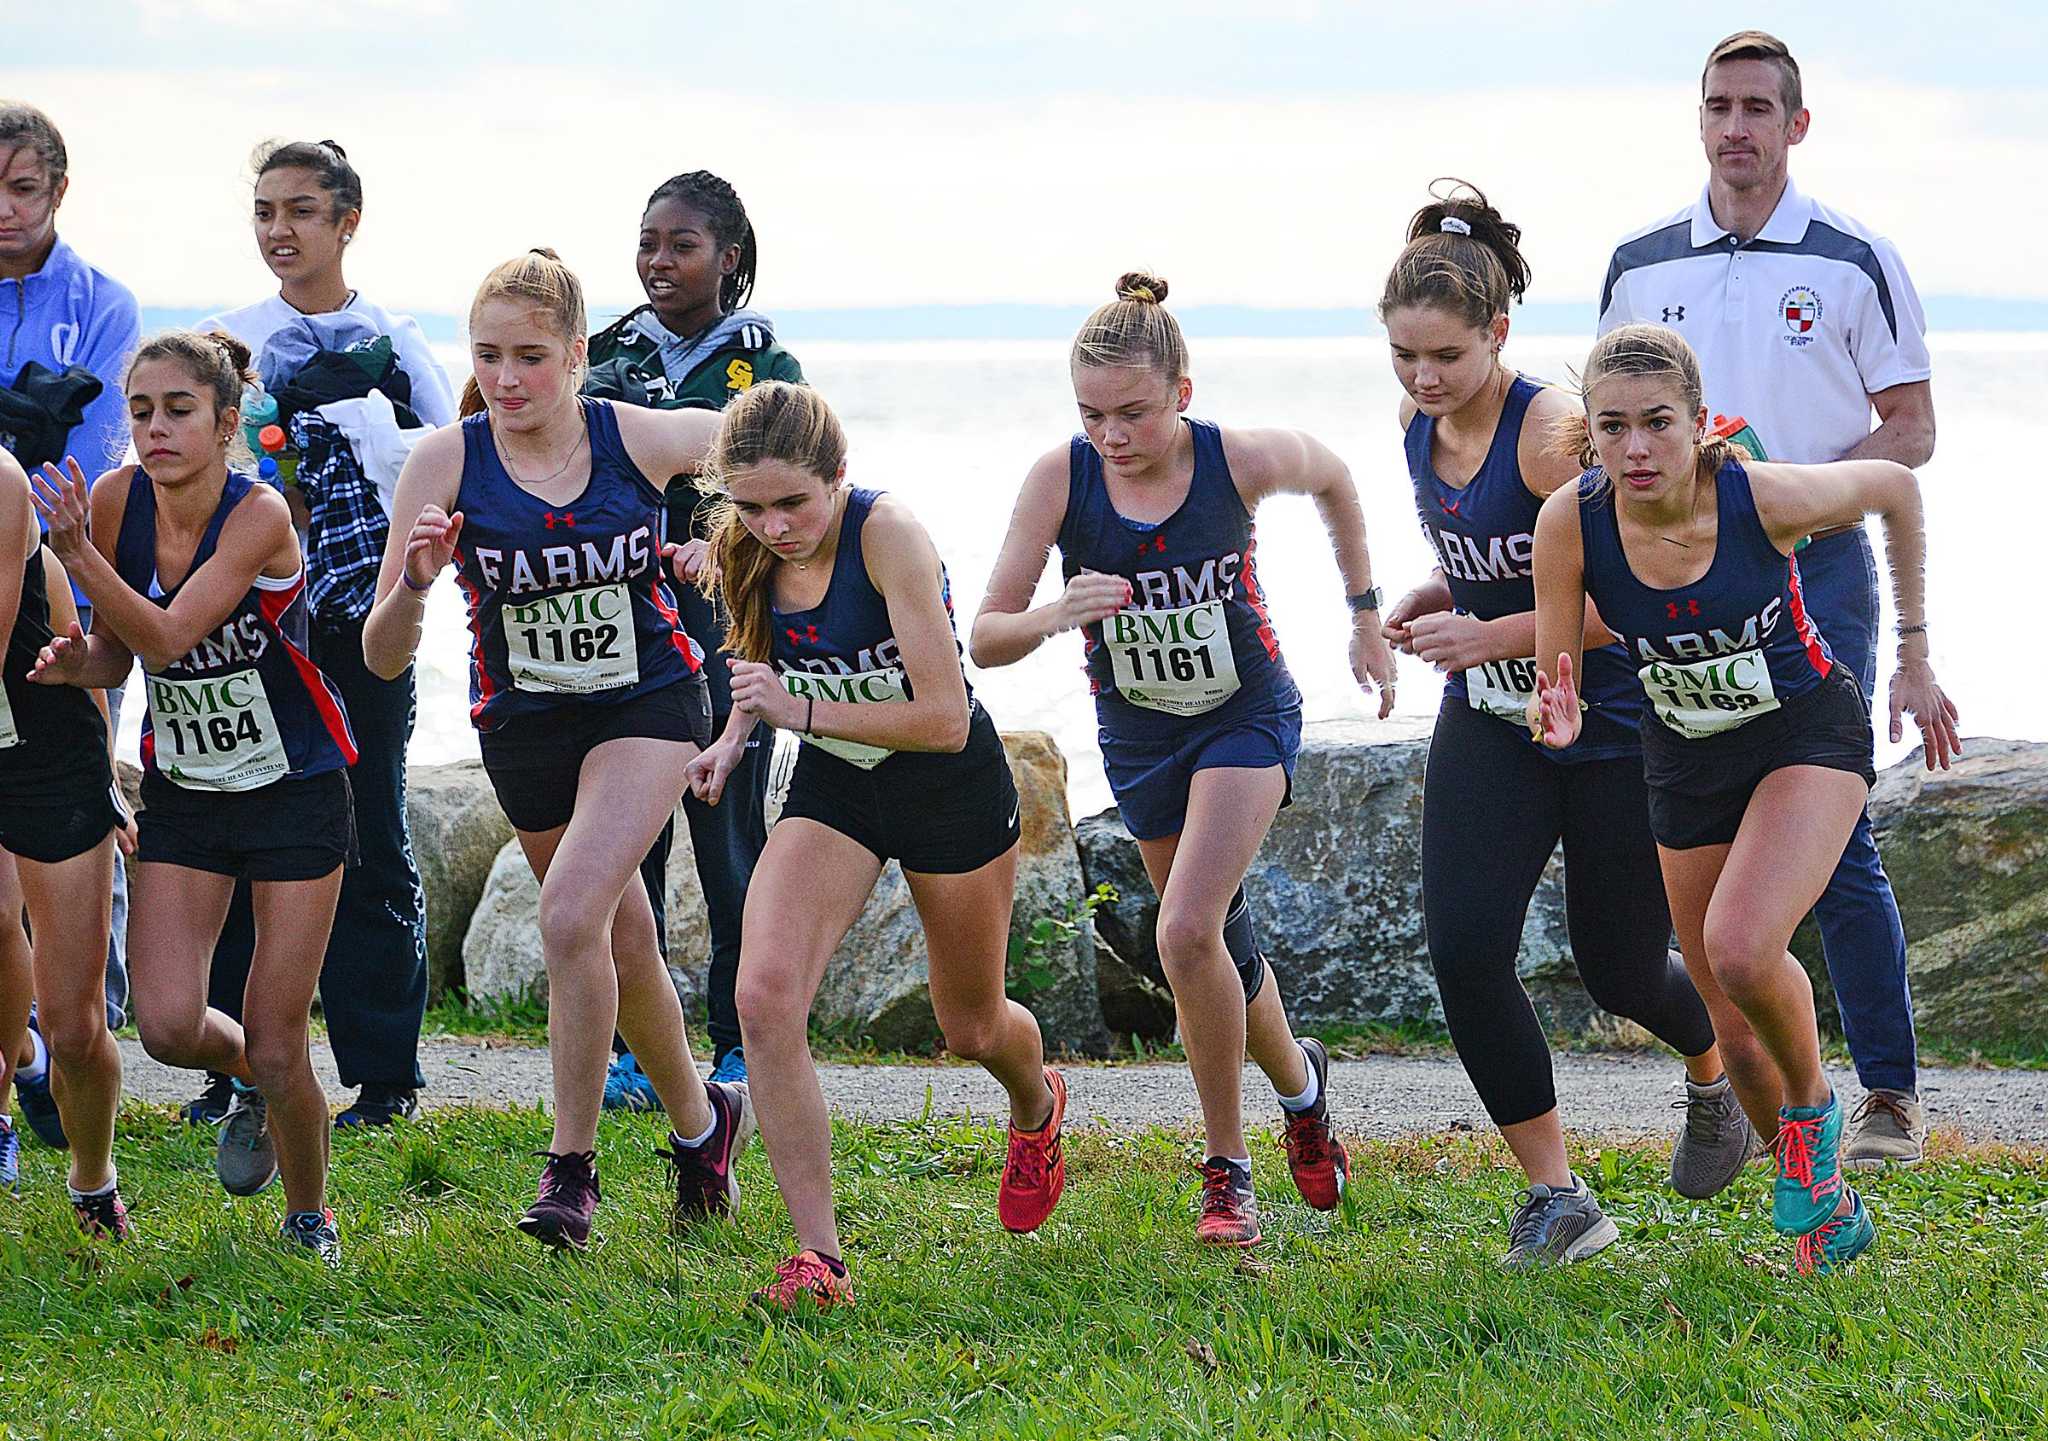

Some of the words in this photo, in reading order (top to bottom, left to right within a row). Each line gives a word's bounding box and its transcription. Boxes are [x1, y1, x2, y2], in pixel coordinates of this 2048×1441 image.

[476, 526, 650, 594] FARMS
[513, 588, 622, 626] BMC
[1114, 606, 1217, 645] BMC
[521, 624, 621, 663] 1162
[1125, 644, 1216, 682] 1161
[785, 673, 895, 704] BMC
[1649, 656, 1760, 692] BMC
[153, 676, 257, 716] BMC
[166, 711, 262, 756] 1164
